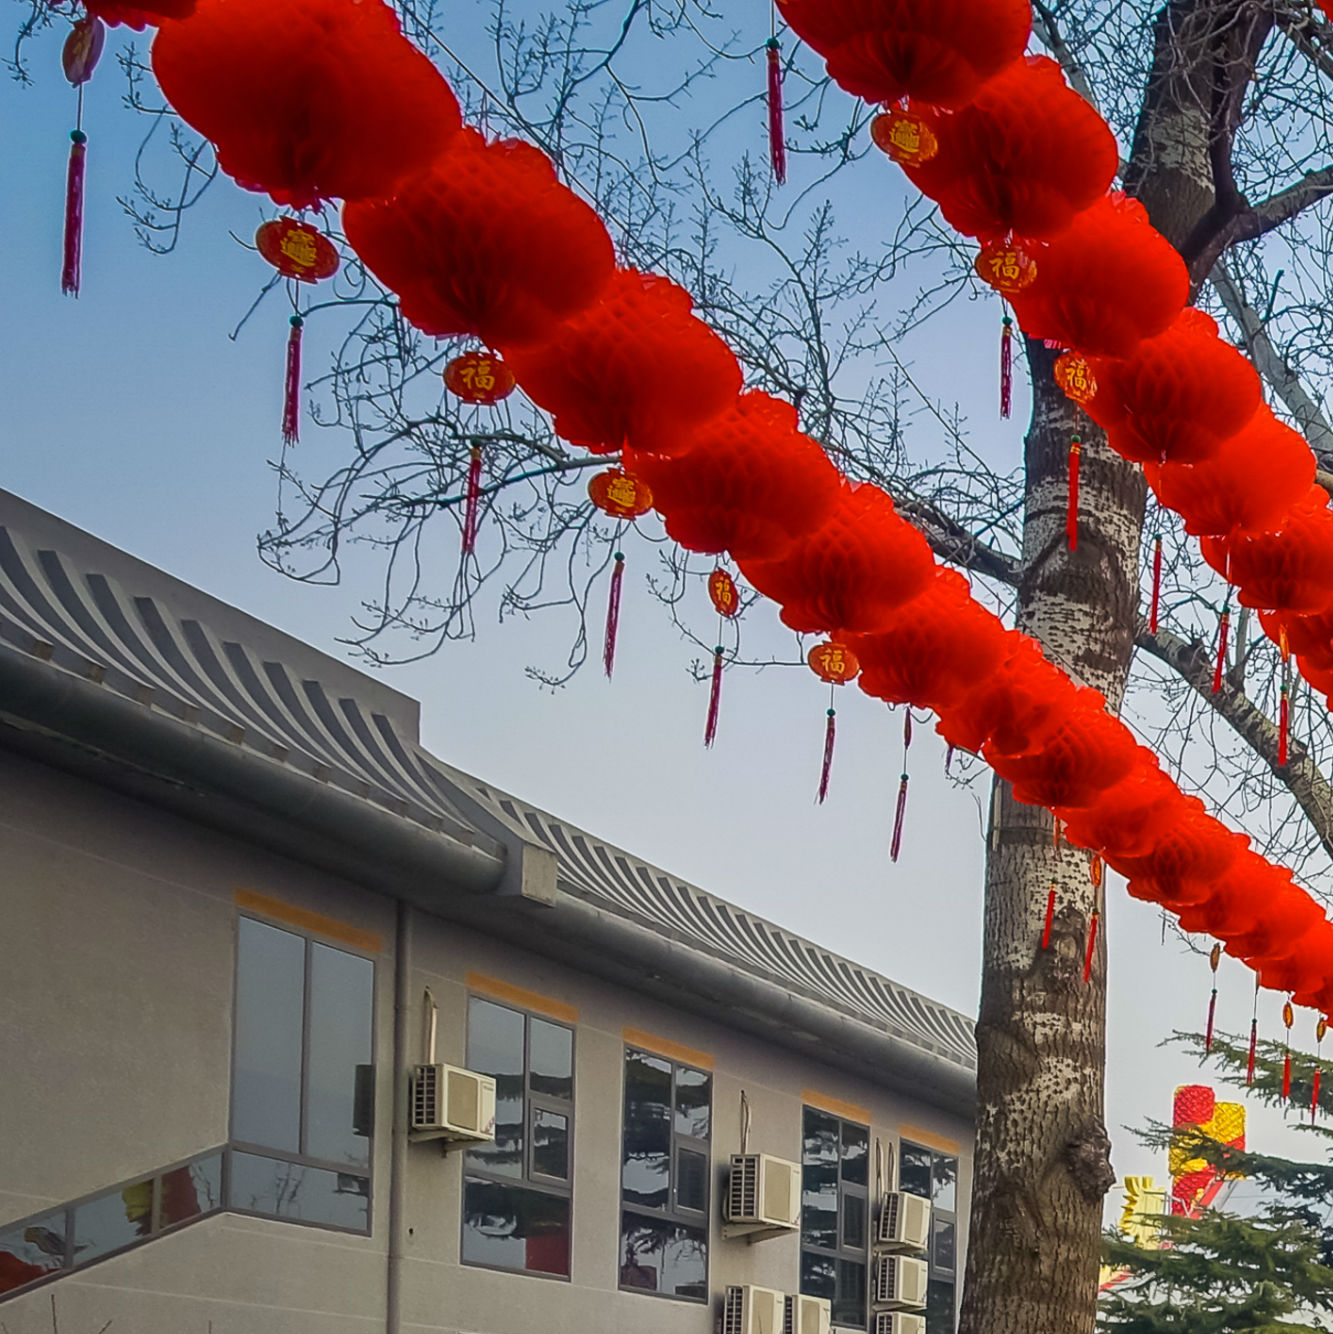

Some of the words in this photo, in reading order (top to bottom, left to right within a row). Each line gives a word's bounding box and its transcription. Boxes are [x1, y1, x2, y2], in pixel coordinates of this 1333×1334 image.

[989, 250, 1021, 281] 福
[460, 360, 495, 391] 福
[1066, 362, 1088, 393] 福
[716, 576, 732, 606] 福
[820, 648, 846, 674] 福
